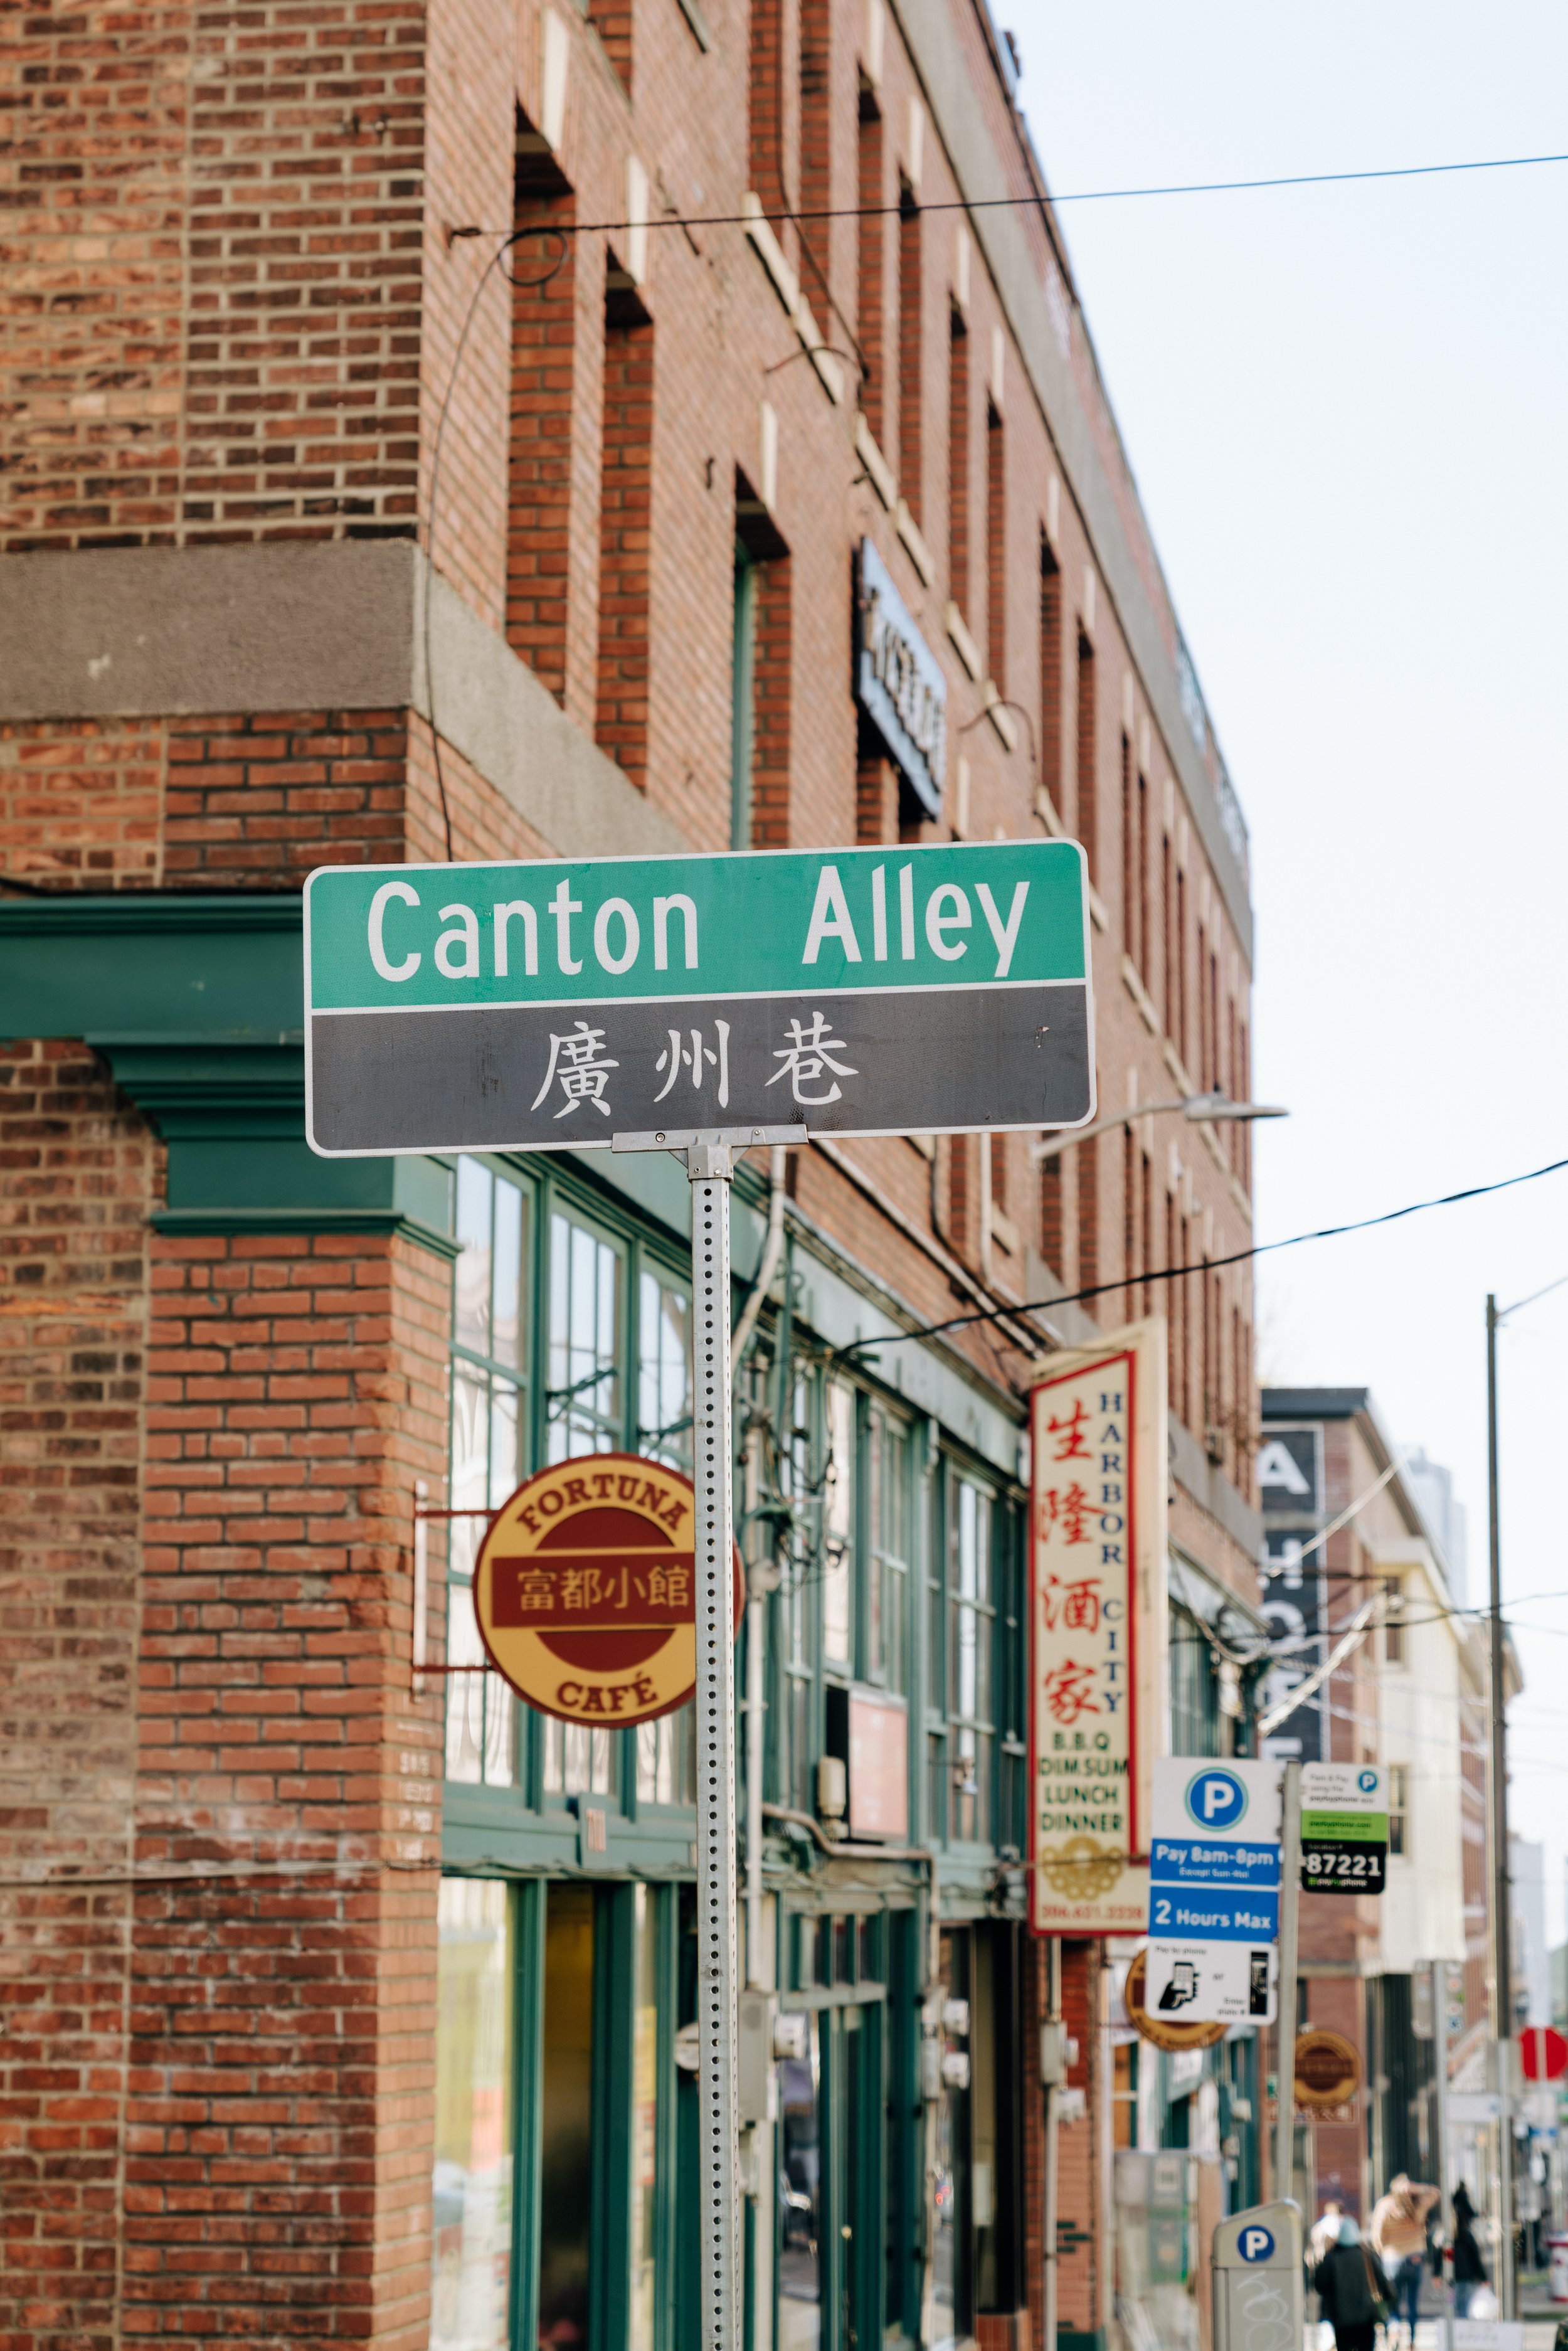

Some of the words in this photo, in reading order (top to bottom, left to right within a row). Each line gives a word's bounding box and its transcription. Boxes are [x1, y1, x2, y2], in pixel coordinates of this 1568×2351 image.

[368, 878, 699, 982] Canton
[802, 862, 1030, 977] Alley
[530, 1011, 859, 1119] 廣州巷
[1100, 1393, 1123, 1564] HARBOR
[516, 1473, 689, 1536] FORTUNA
[518, 1566, 689, 1611] 富都小館
[1102, 1601, 1124, 1713] CITY
[556, 1671, 659, 1712] CAFÉ
[1084, 1758, 1128, 1777] SUM
[1046, 1785, 1118, 1805] LUNCH
[1042, 1812, 1123, 1832] DINNER
[1156, 1844, 1188, 1865] Pay
[1191, 1845, 1274, 1869] 8am-8pm
[1306, 1853, 1381, 1877] 87221
[1155, 1899, 1172, 1925] 2
[1177, 1909, 1230, 1928] Hours
[1234, 1911, 1271, 1929] Max
[1246, 2231, 1269, 2259] P
